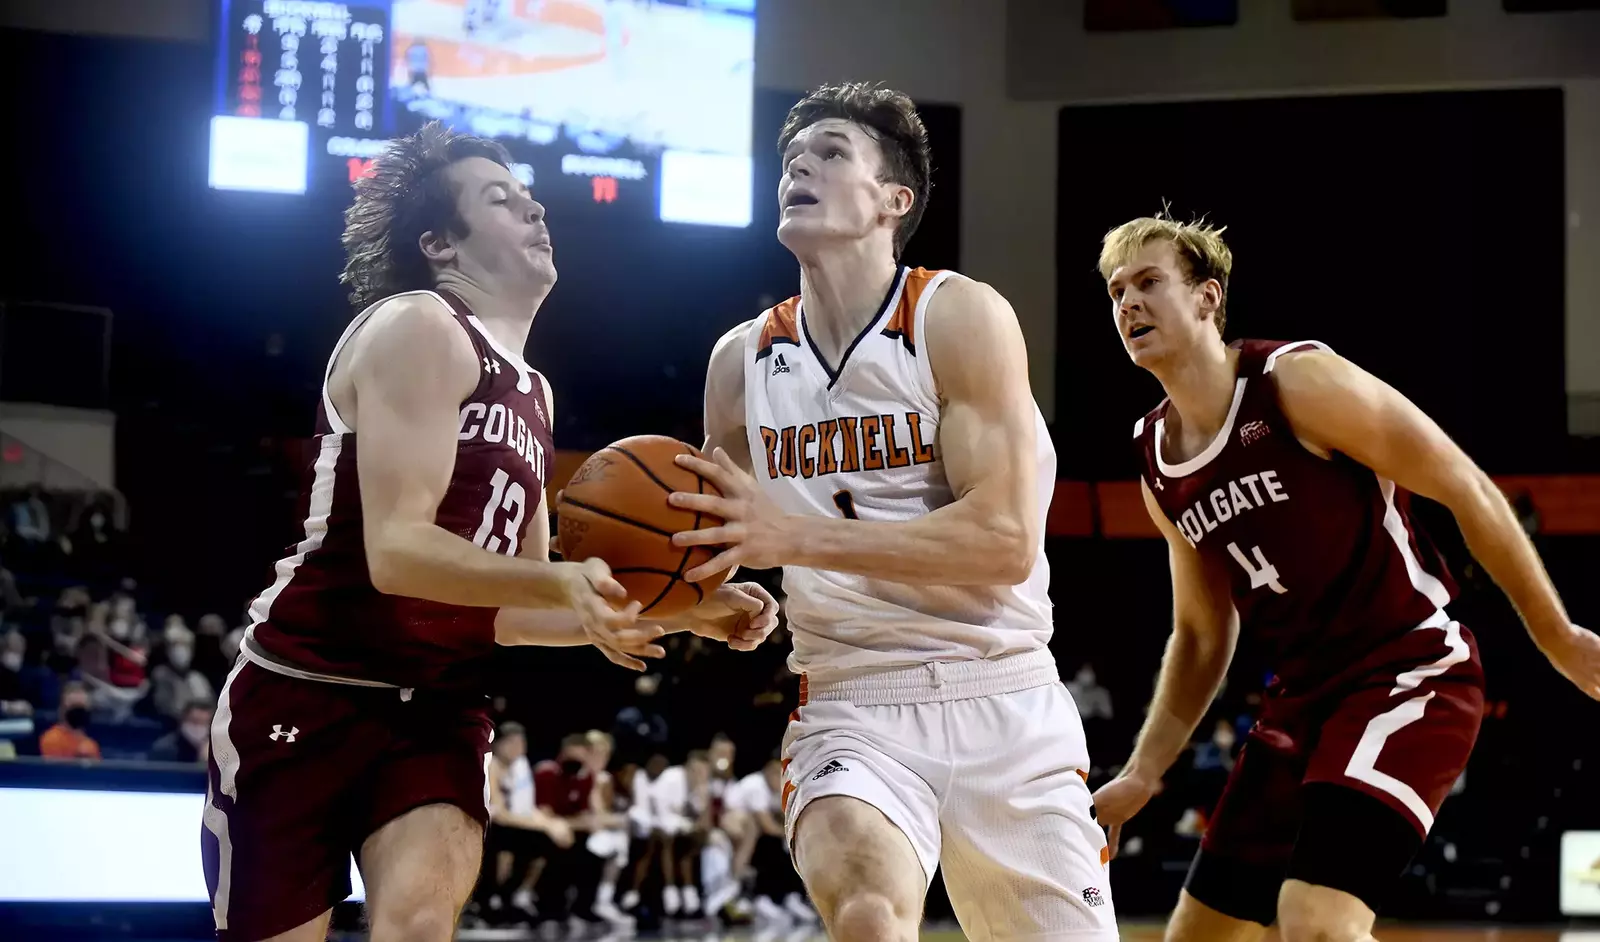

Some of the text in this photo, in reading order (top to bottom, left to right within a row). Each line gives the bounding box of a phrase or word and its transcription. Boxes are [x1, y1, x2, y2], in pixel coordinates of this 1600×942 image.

[772, 365, 790, 376] adas
[458, 402, 545, 489] COLGAT
[472, 467, 526, 557] 13
[1226, 541, 1289, 594] 4
